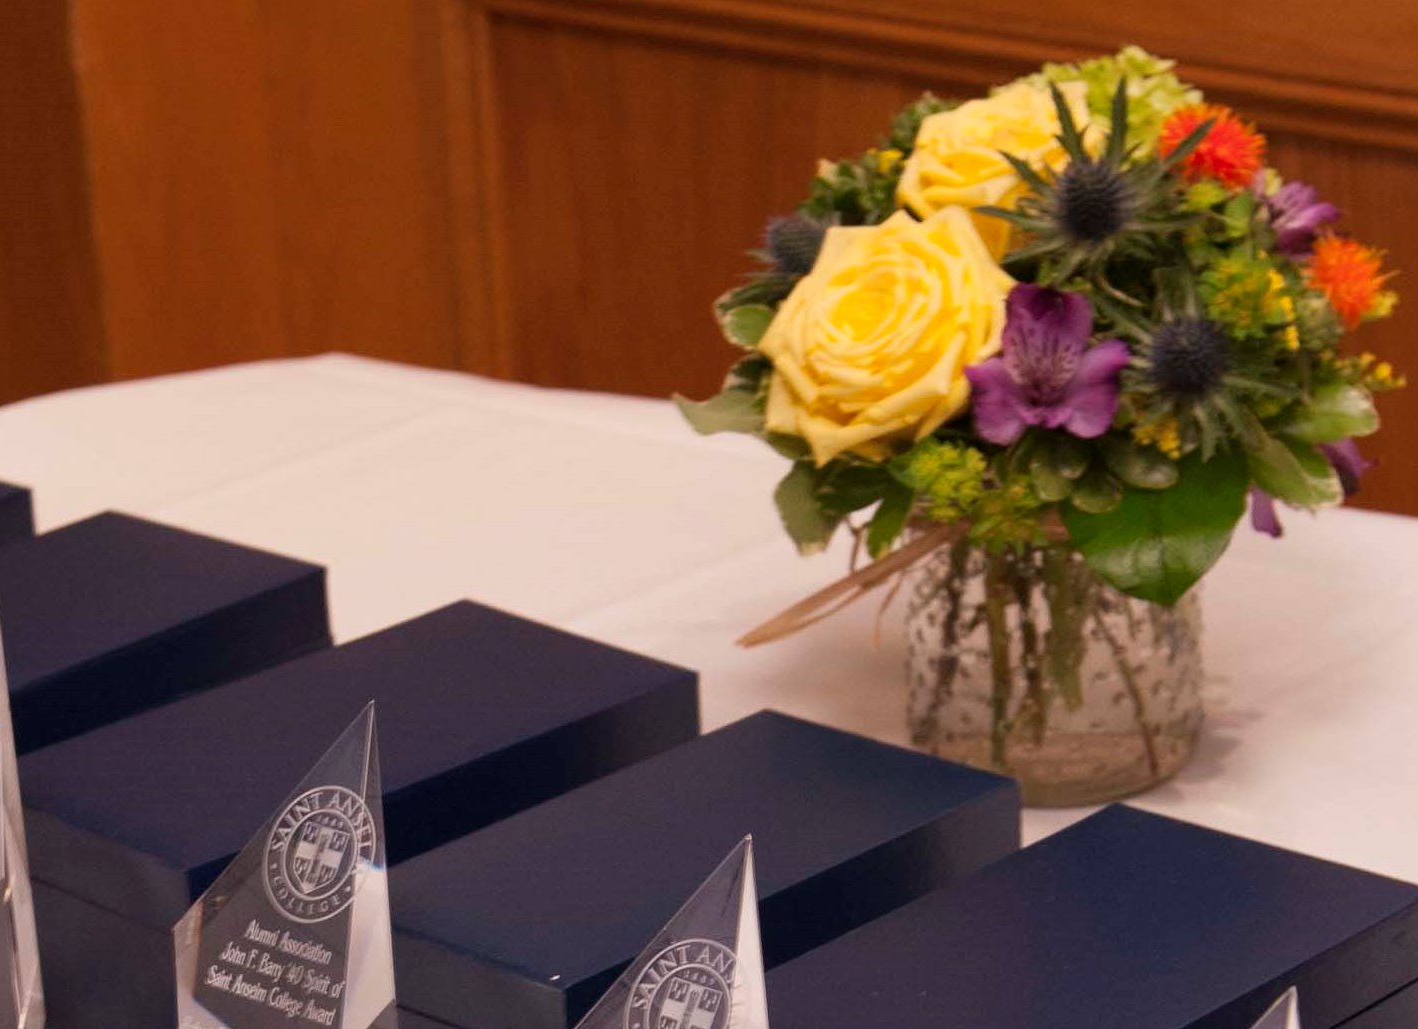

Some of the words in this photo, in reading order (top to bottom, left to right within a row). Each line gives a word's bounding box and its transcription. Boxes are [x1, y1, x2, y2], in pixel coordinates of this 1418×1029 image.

[272, 791, 324, 851] SAINT
[272, 874, 342, 916] COLLEGE
[219, 941, 246, 966] John
[303, 968, 331, 997] Spirit
[331, 979, 347, 999] of
[244, 919, 279, 948] Alumni
[280, 932, 332, 965] Association
[204, 964, 233, 990] Saint
[233, 973, 268, 1003] Anselm
[269, 986, 303, 1018] College
[303, 999, 336, 1026] Award
[633, 945, 691, 1010] SAINT
